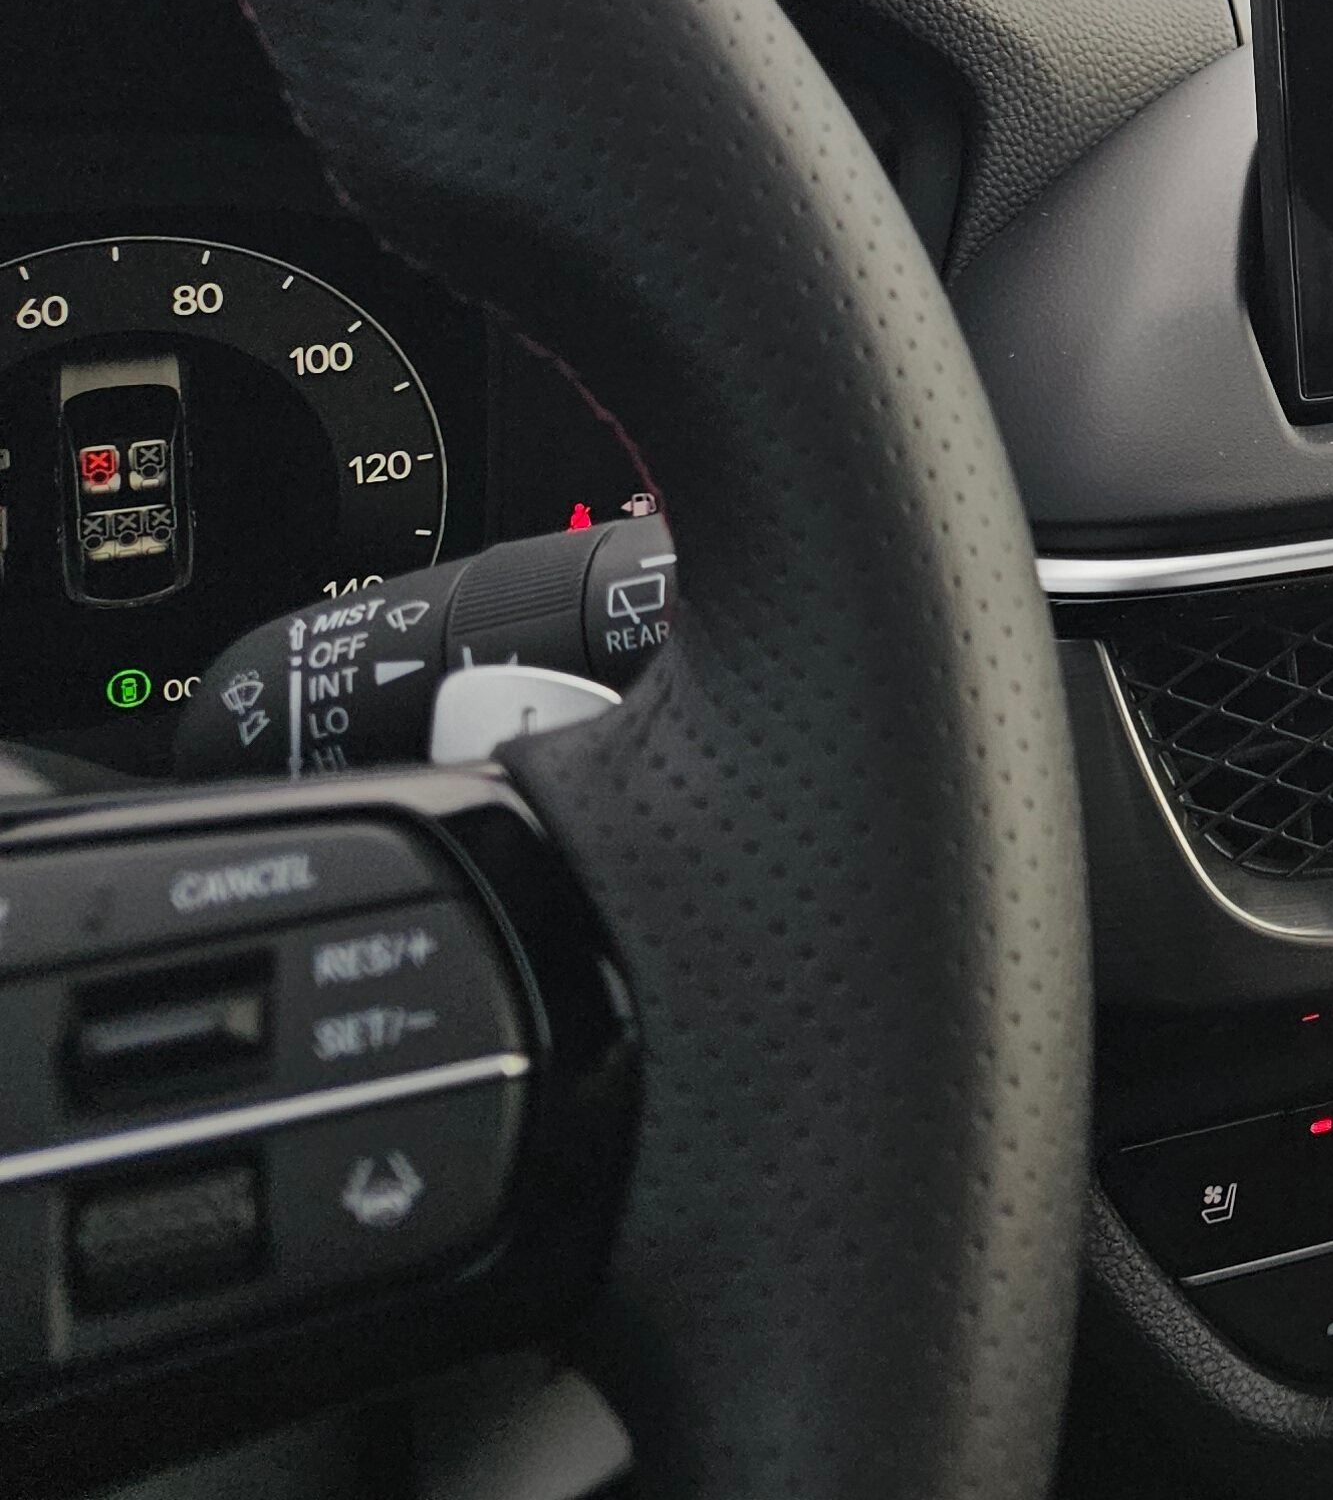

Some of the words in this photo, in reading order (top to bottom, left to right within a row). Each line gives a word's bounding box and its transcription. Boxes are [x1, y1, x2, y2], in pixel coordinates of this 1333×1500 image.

[15, 294, 69, 330] 60
[172, 282, 224, 316] 80
[289, 342, 354, 376] 100
[348, 450, 412, 484] 120
[312, 599, 386, 634] MIST
[309, 632, 369, 668] OFF
[606, 620, 669, 653] REAR
[309, 667, 359, 702] INT
[309, 707, 349, 739] LO
[170, 854, 316, 912] CANCEL
